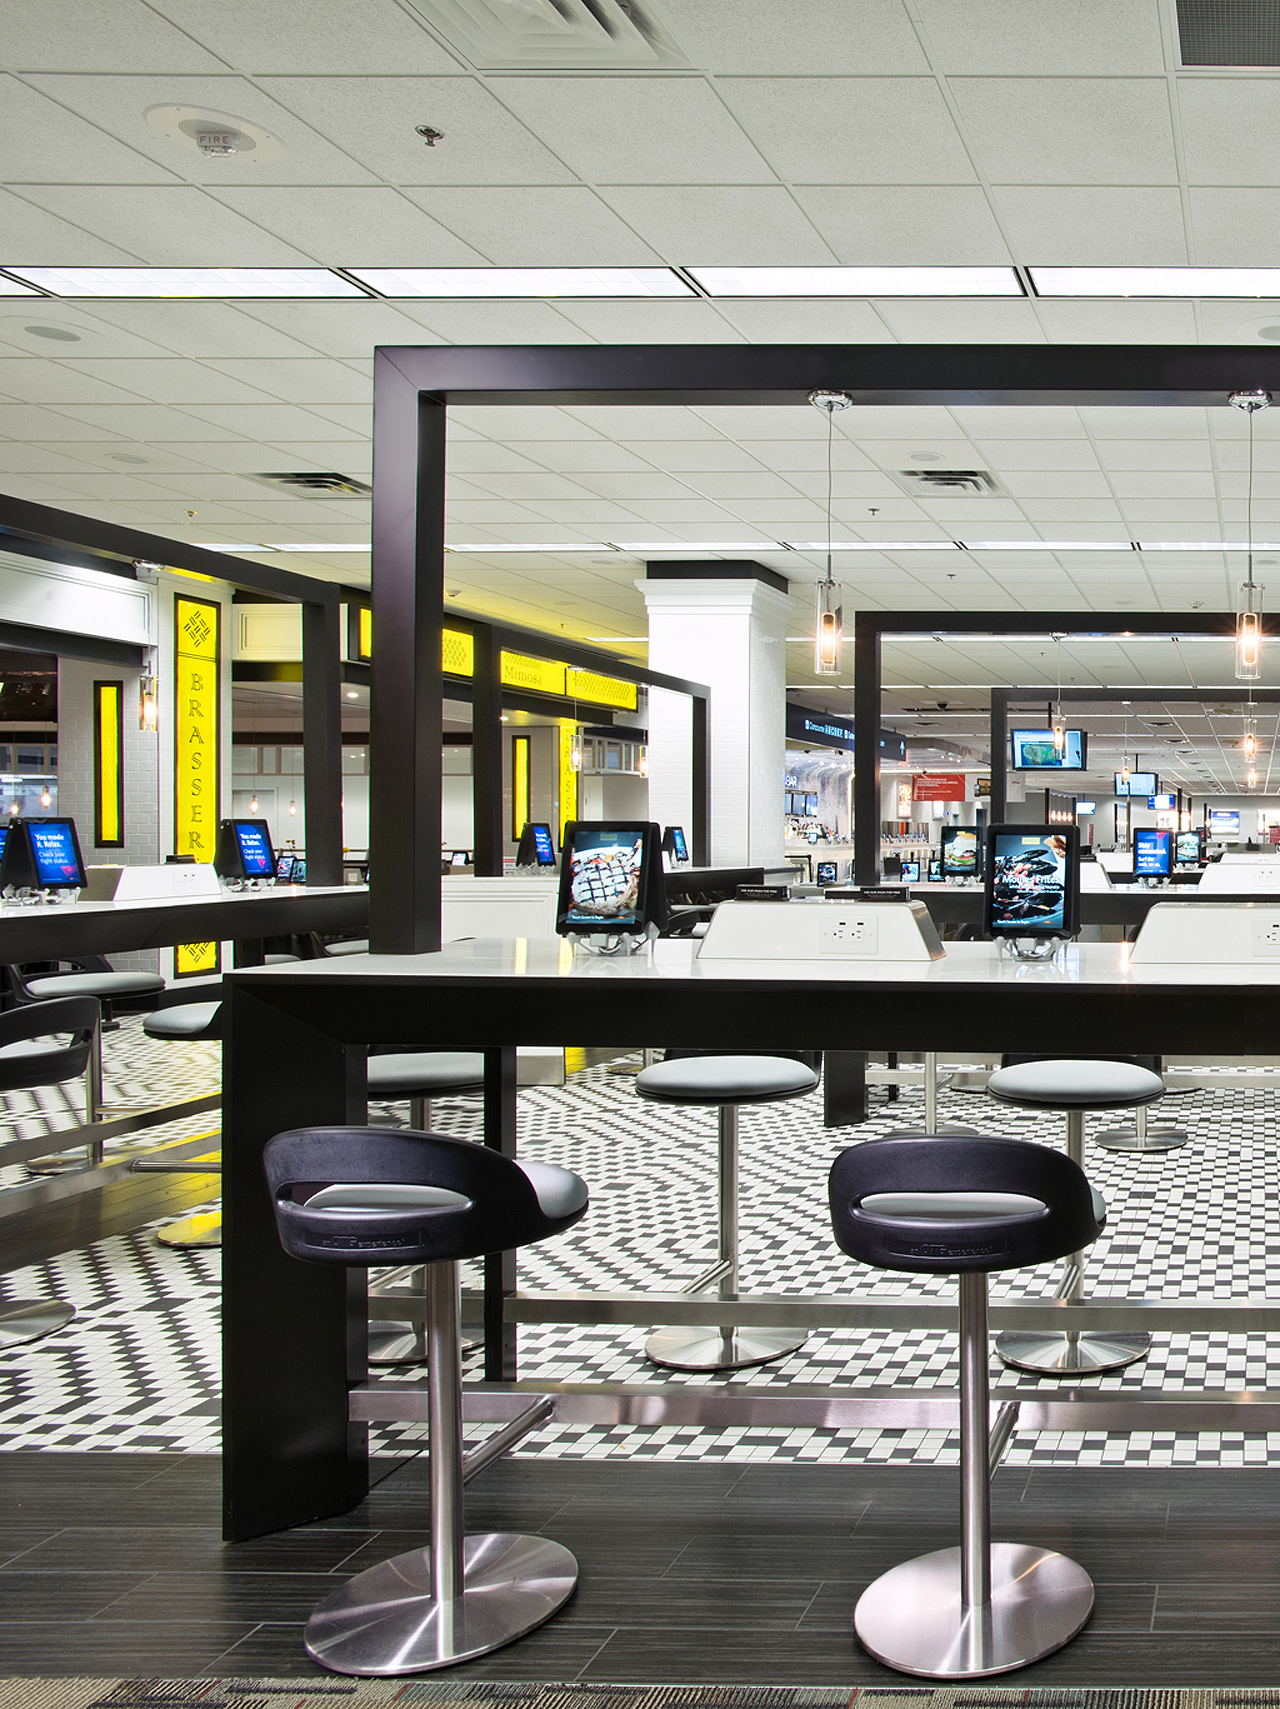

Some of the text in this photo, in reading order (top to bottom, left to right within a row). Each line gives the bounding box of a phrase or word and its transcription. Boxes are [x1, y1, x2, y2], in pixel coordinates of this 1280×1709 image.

[200, 136, 229, 144] FIRE
[504, 666, 542, 685] Mimosa
[188, 673, 204, 850] BRASSER
[1036, 874, 1059, 883] Frites
